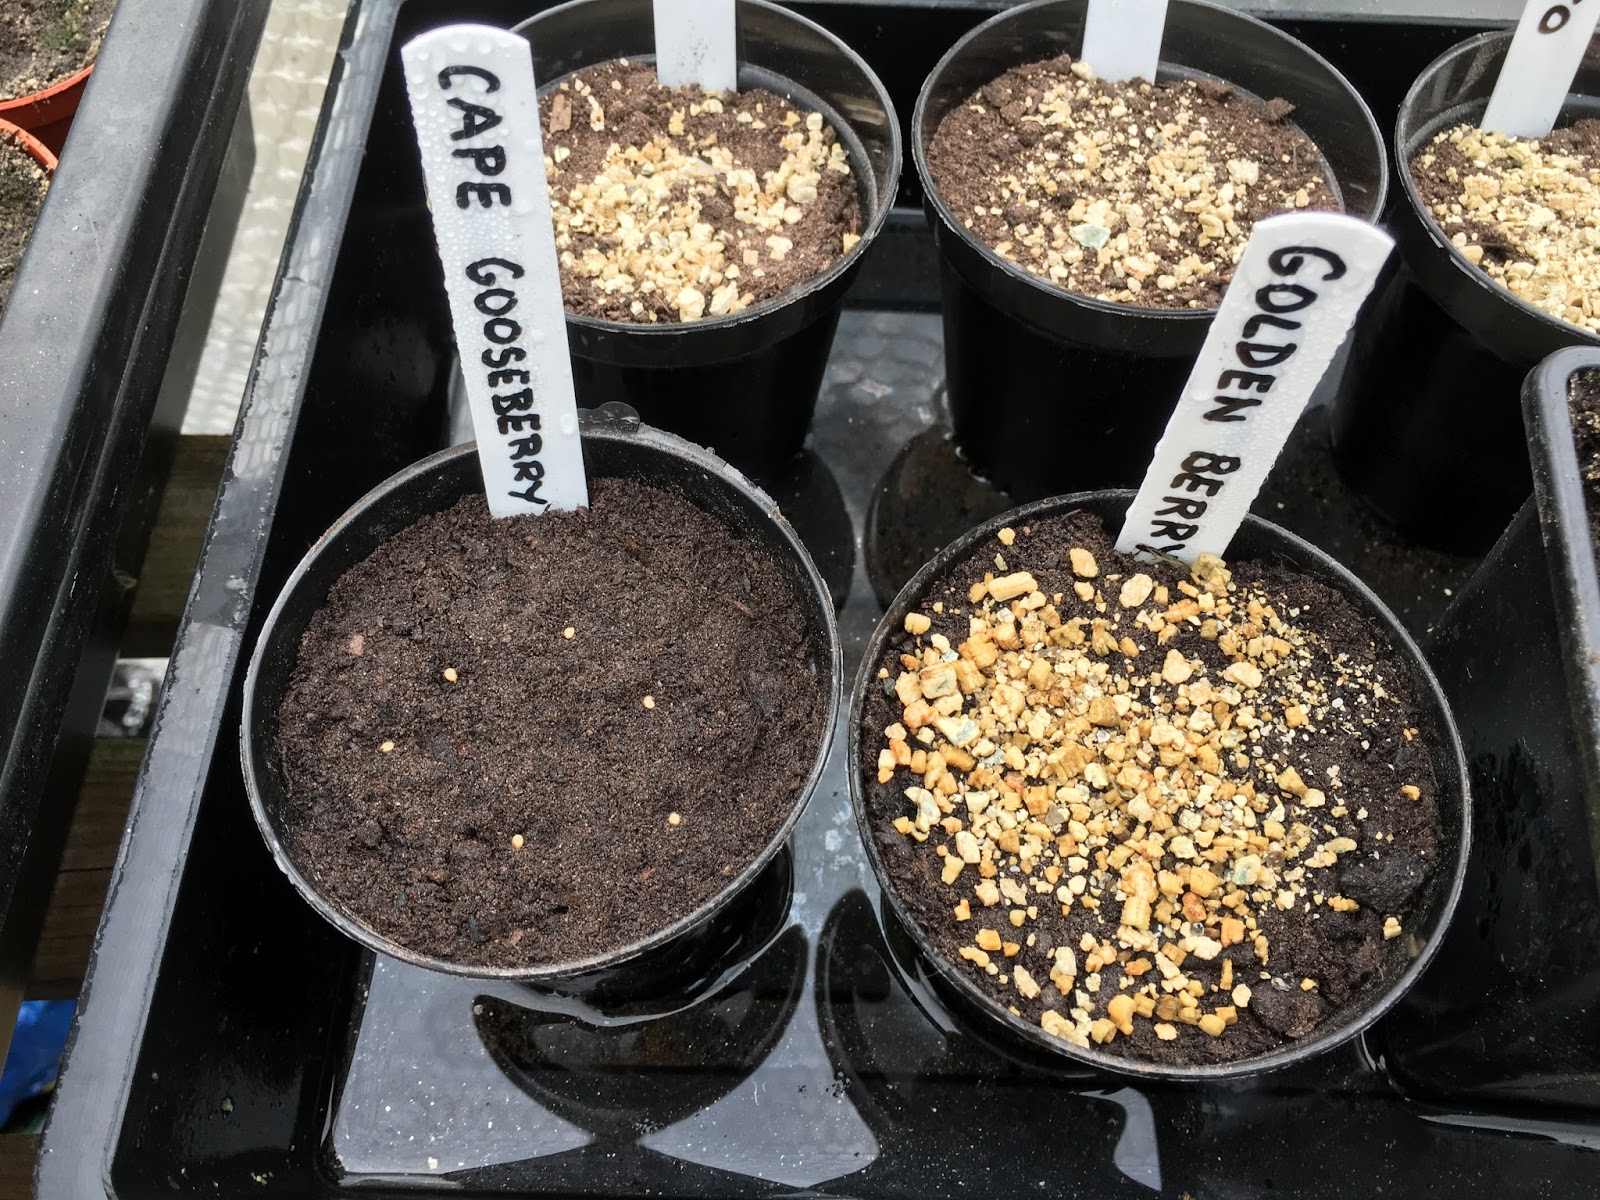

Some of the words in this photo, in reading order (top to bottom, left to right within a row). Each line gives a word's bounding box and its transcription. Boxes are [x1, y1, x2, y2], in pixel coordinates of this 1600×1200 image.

[438, 65, 512, 210] CAPE
[466, 257, 548, 506] GOOSEBERRY
[1203, 246, 1347, 422] GOLDEN
